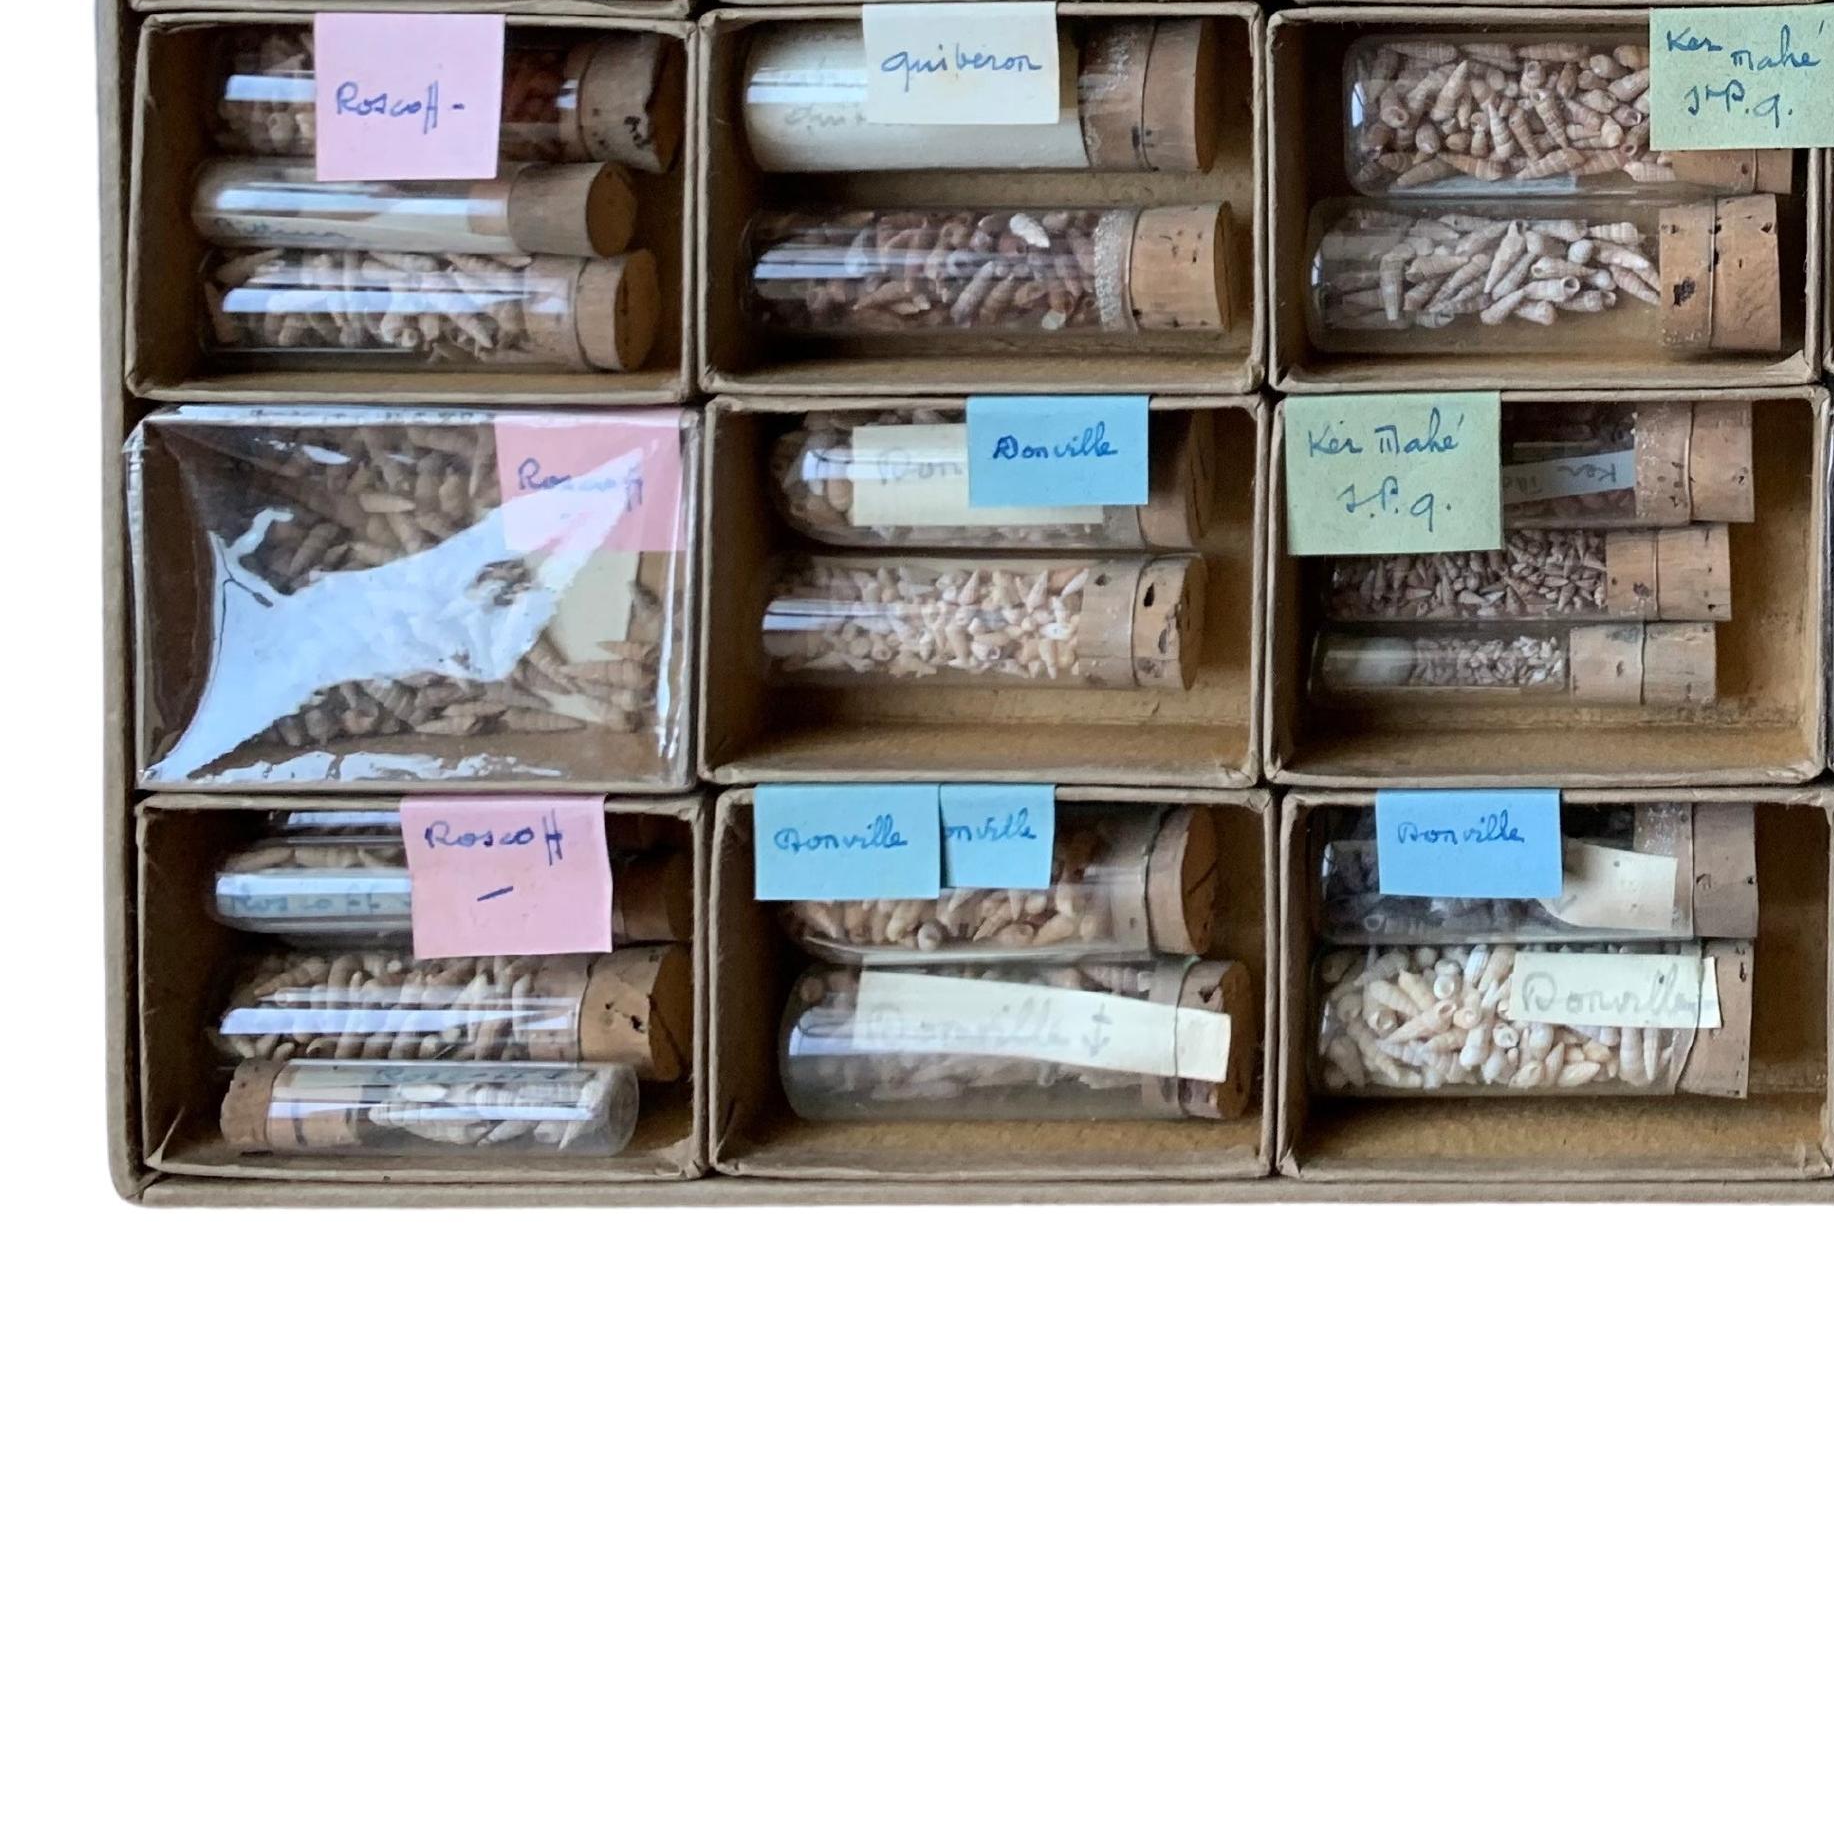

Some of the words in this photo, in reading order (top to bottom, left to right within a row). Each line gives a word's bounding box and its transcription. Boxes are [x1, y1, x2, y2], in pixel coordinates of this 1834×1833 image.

[993, 420, 1118, 462] Donville
[424, 809, 564, 866] Roscoff
[773, 813, 908, 852] Donville
[943, 805, 1037, 842] onville
[1396, 809, 1526, 845] Donville
